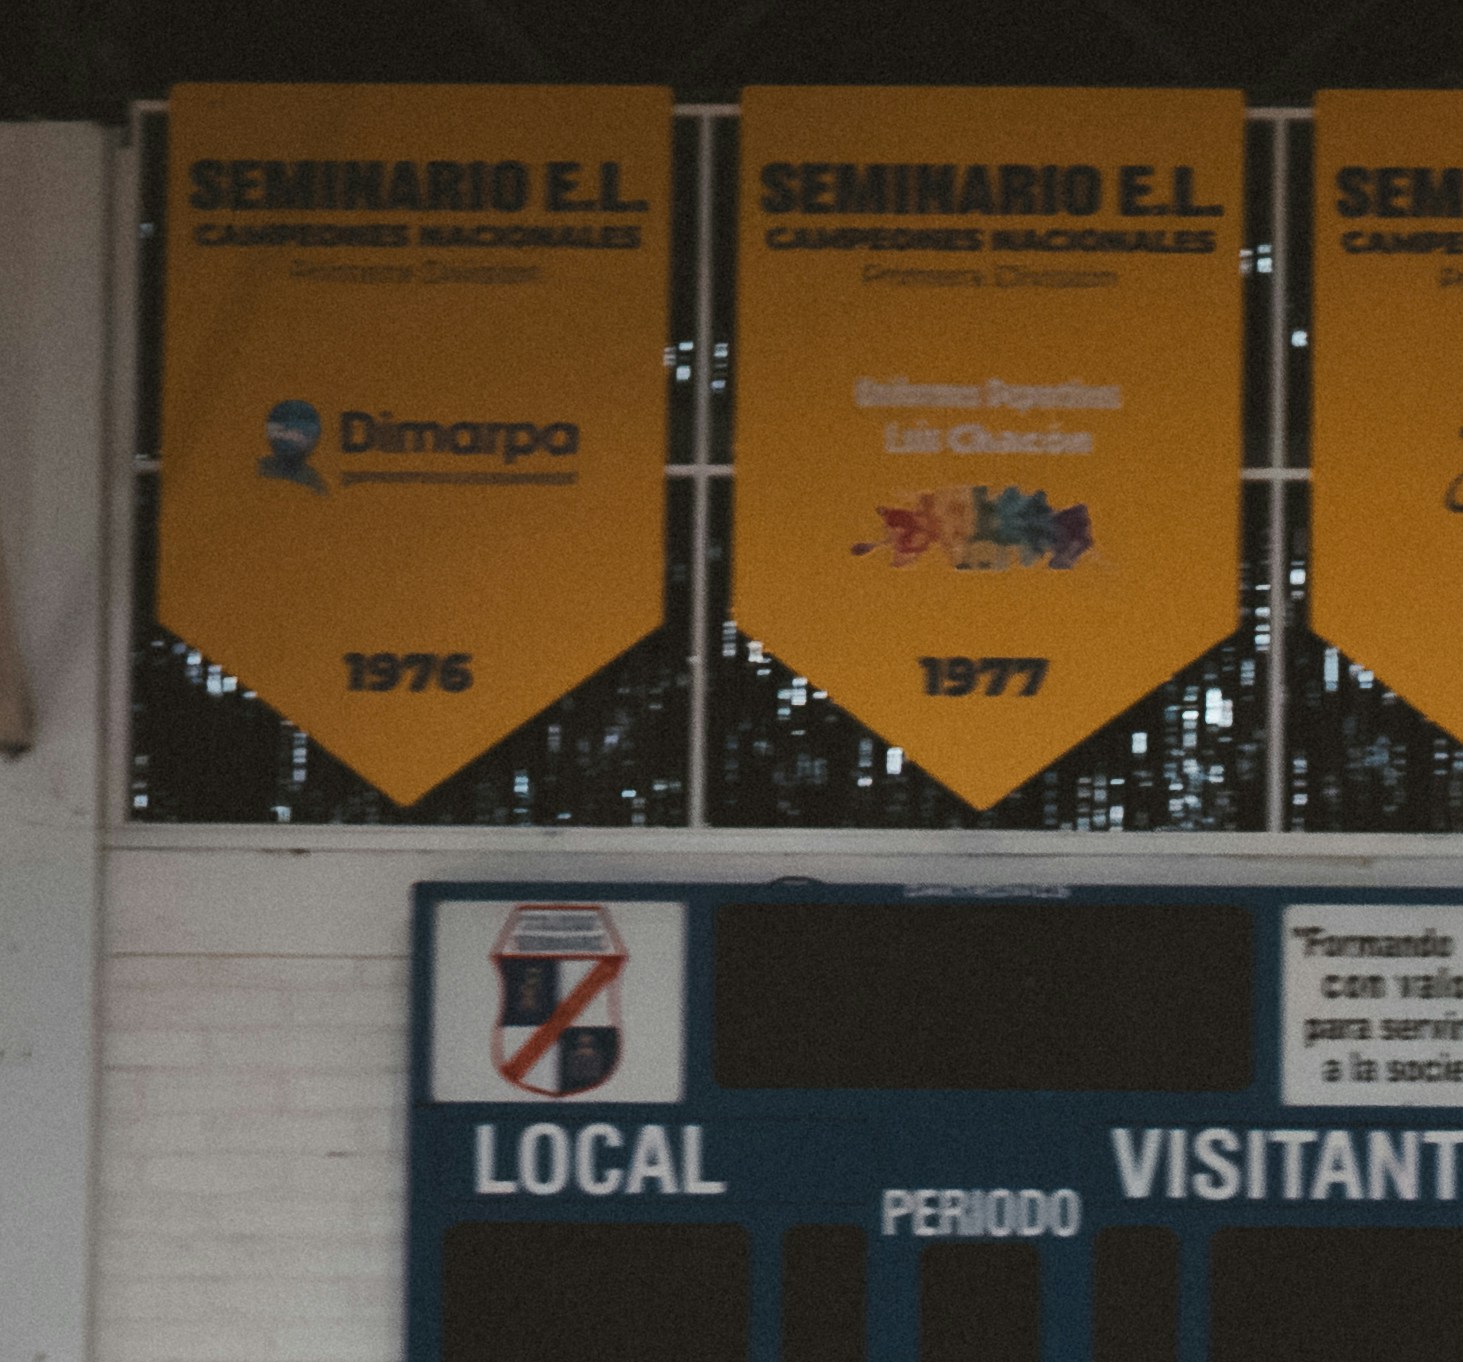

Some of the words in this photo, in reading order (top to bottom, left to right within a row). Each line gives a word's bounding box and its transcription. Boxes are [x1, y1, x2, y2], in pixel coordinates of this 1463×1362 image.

[189, 159, 530, 212] SEMINARIO
[761, 162, 1103, 216] SEMINARIO
[194, 223, 409, 248] CAMPEONES
[419, 225, 642, 250] NACIONALES
[765, 227, 983, 252] CAMPEONES
[992, 229, 1218, 254] NACIONALES
[340, 411, 579, 464] Dimarpa
[343, 652, 475, 693] 1976
[918, 656, 1051, 697] 1977
[1303, 1017, 1371, 1048] para
[475, 1122, 727, 1195] LOCAL
[881, 1187, 1084, 1238] PERIODO
